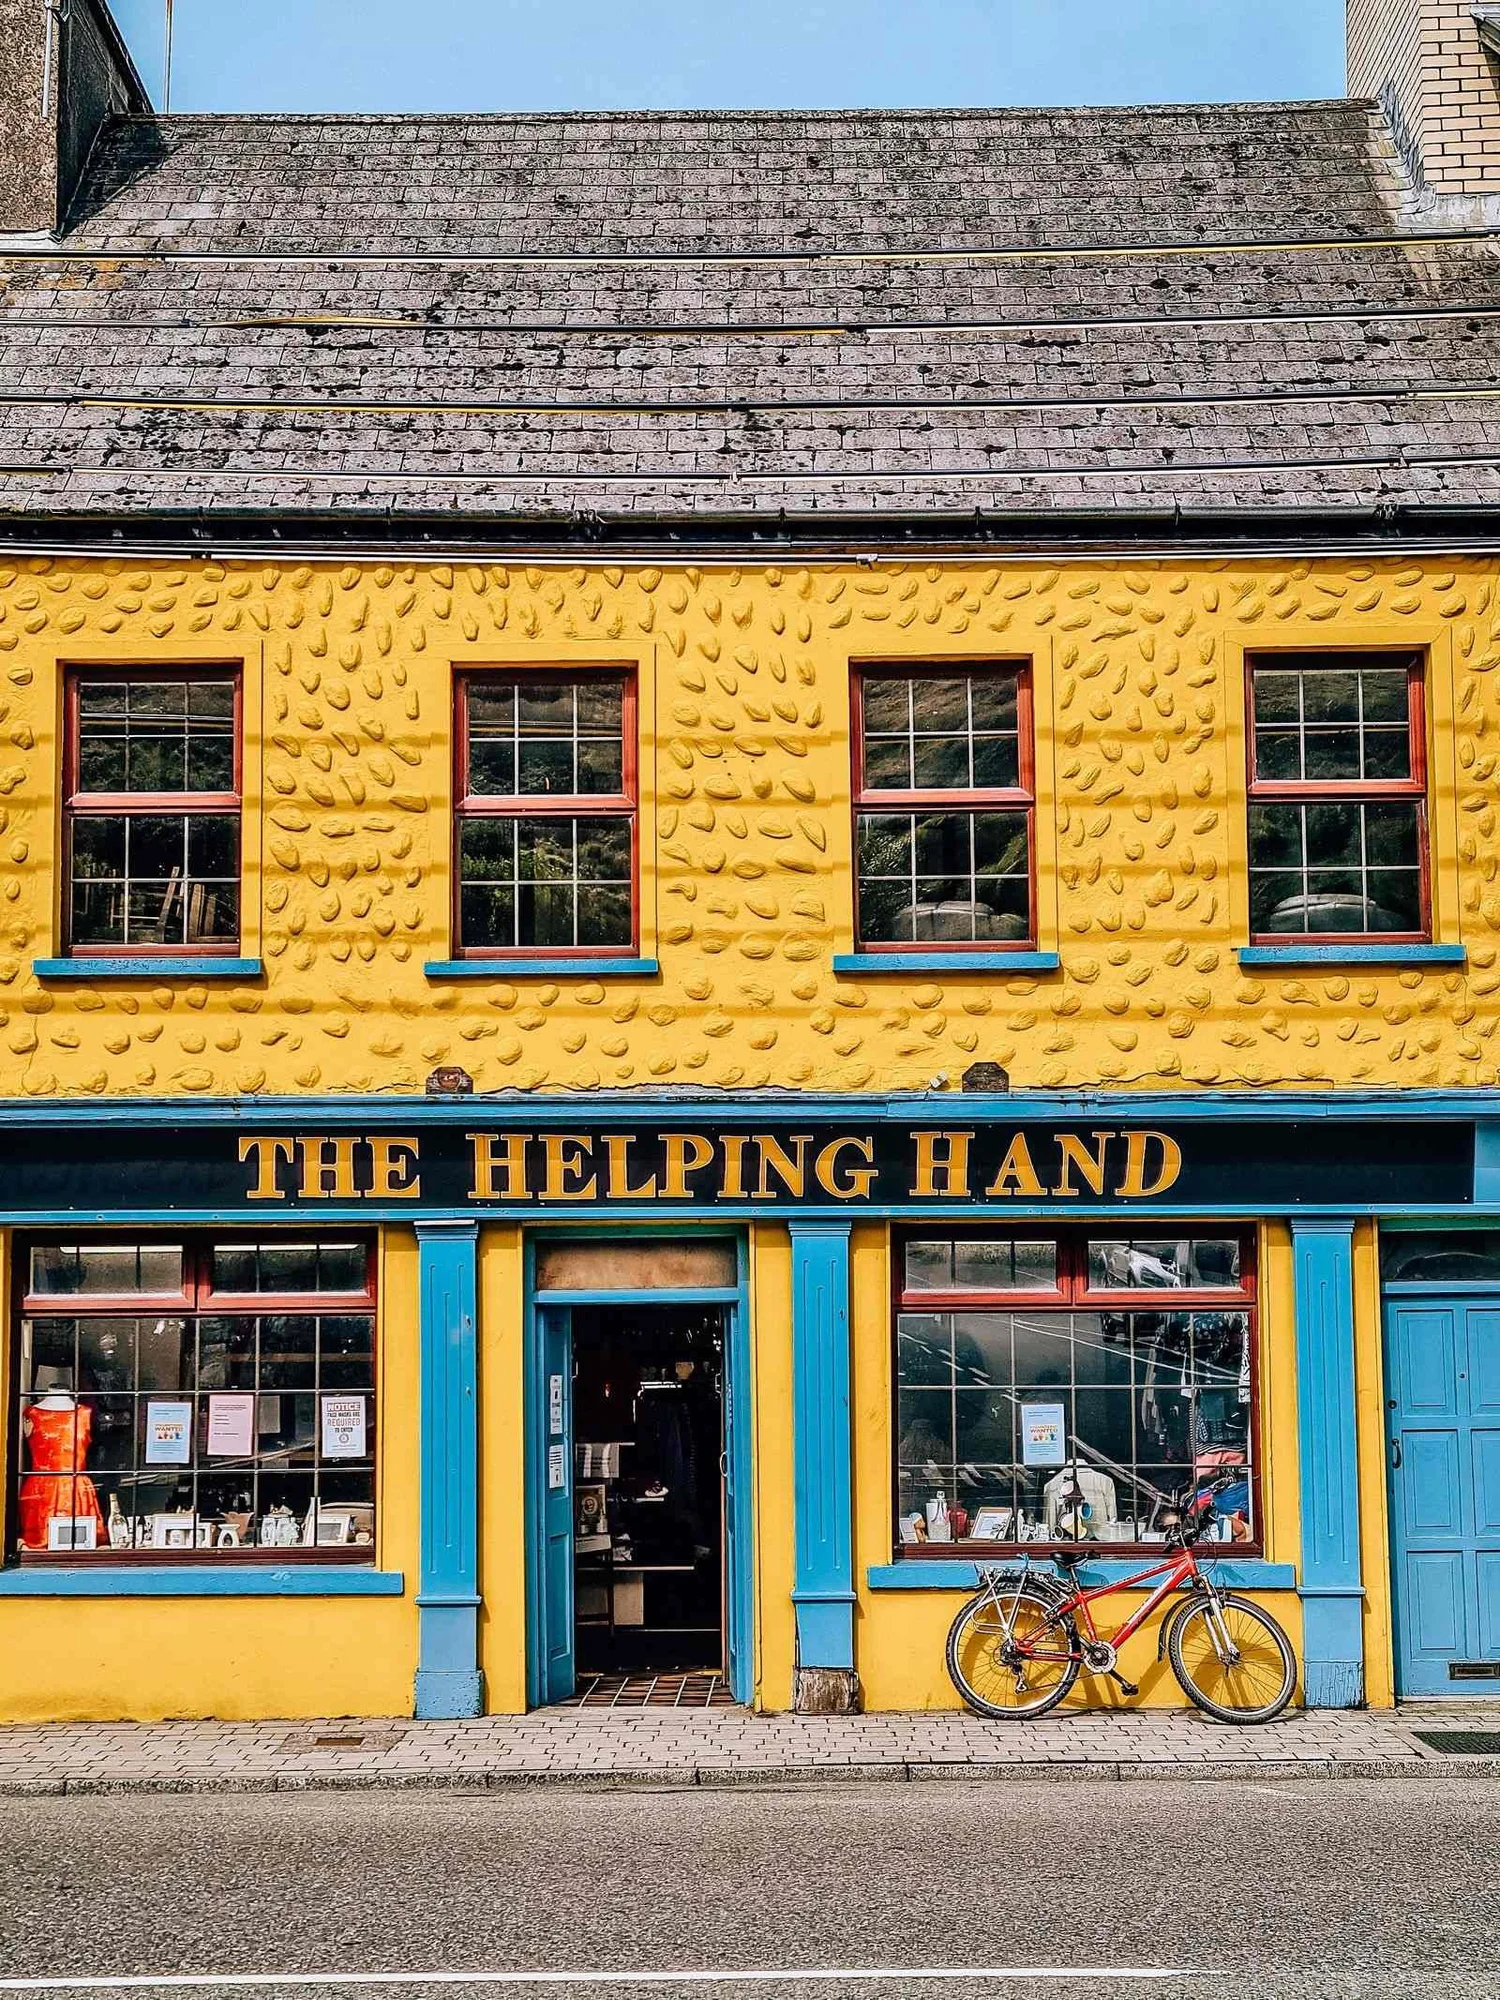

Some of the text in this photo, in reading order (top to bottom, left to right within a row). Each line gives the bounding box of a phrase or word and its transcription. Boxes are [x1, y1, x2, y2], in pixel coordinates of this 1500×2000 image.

[238, 1131, 1182, 1200] THE HELPING HAND
[327, 1402, 360, 1411] NOTICE
[327, 1418, 360, 1426] REQUIRED
